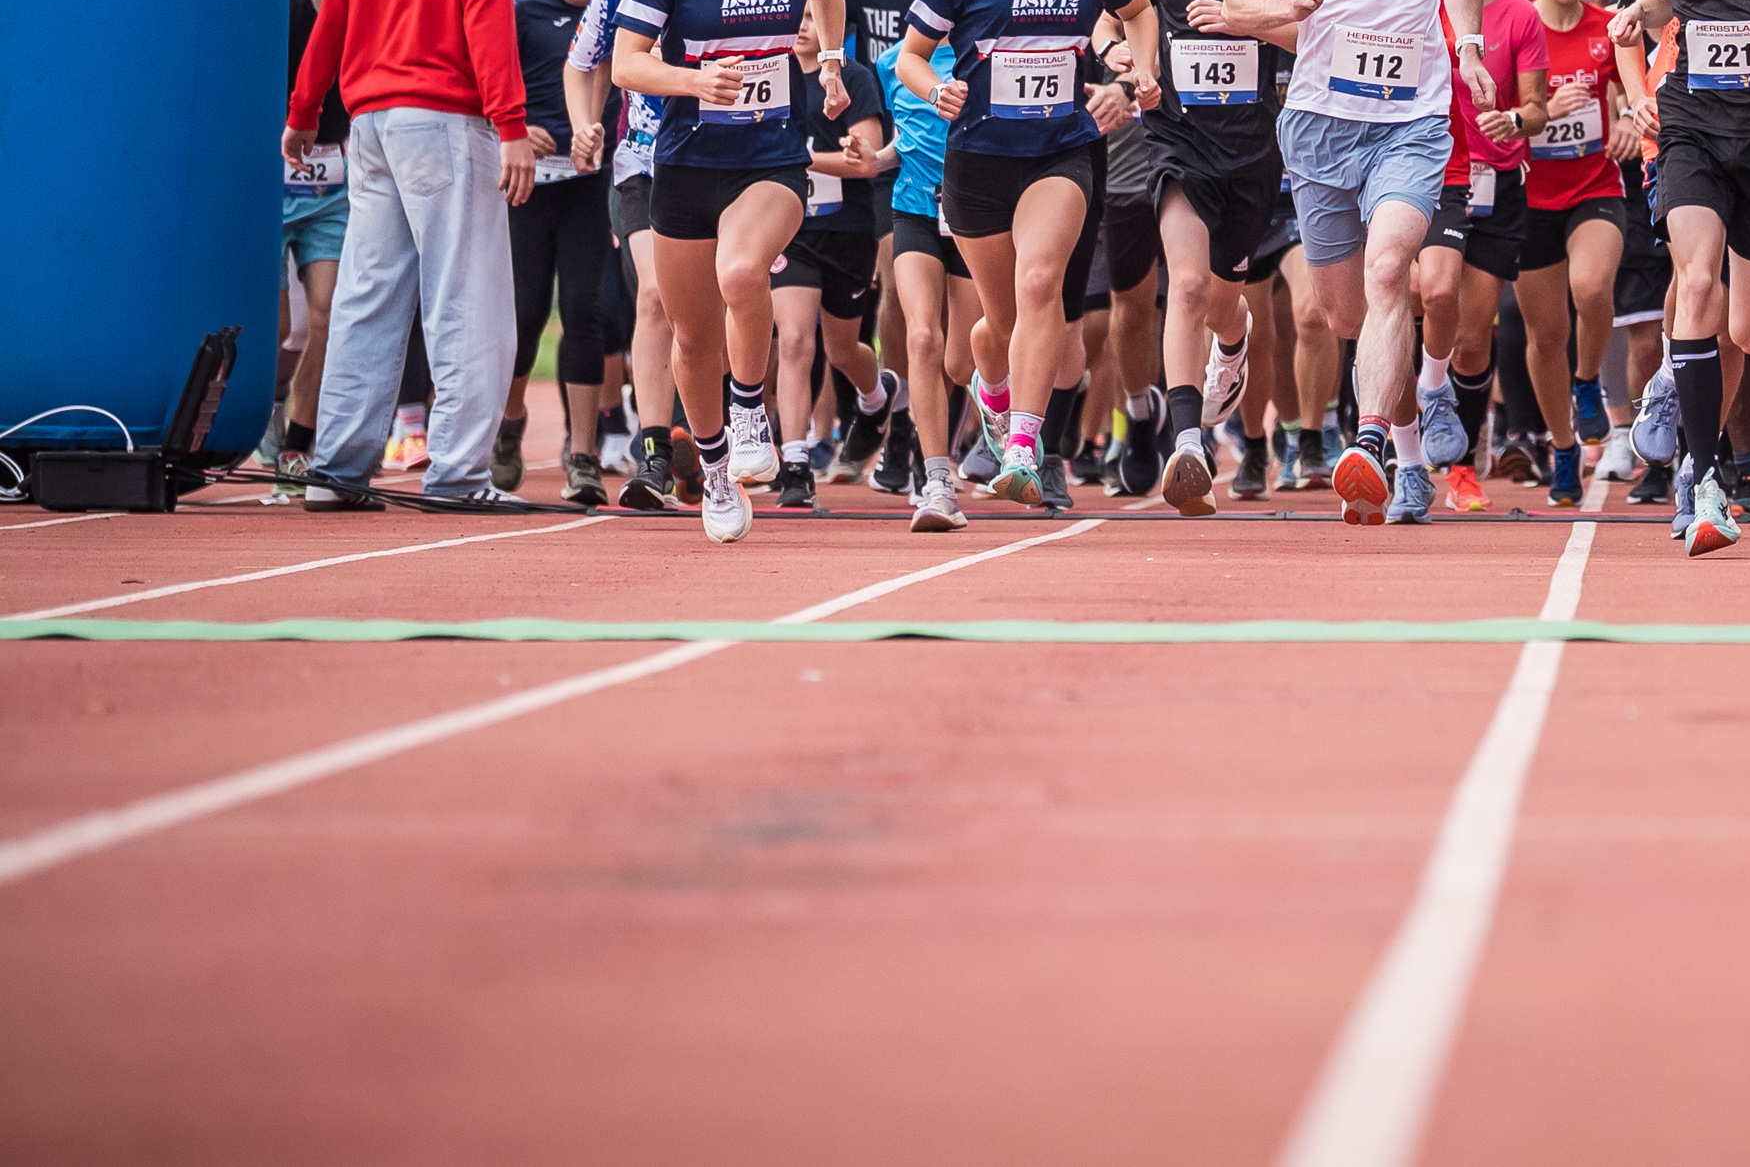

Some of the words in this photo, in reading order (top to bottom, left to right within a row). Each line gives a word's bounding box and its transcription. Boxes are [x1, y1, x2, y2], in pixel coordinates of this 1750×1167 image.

[721, 4, 791, 18] DARMSTADT
[1012, 8, 1079, 17] DARMSTADT
[862, 6, 901, 39] THE
[1347, 31, 1415, 45] HERBSTLAUF
[1180, 44, 1247, 52] HERBSTLAUF
[1004, 55, 1068, 65] HERBSTLAUF
[1355, 51, 1403, 80] 112
[1190, 62, 1236, 85] 143
[1015, 74, 1059, 99] 175
[1545, 121, 1586, 144] 228
[290, 163, 328, 182] 232
